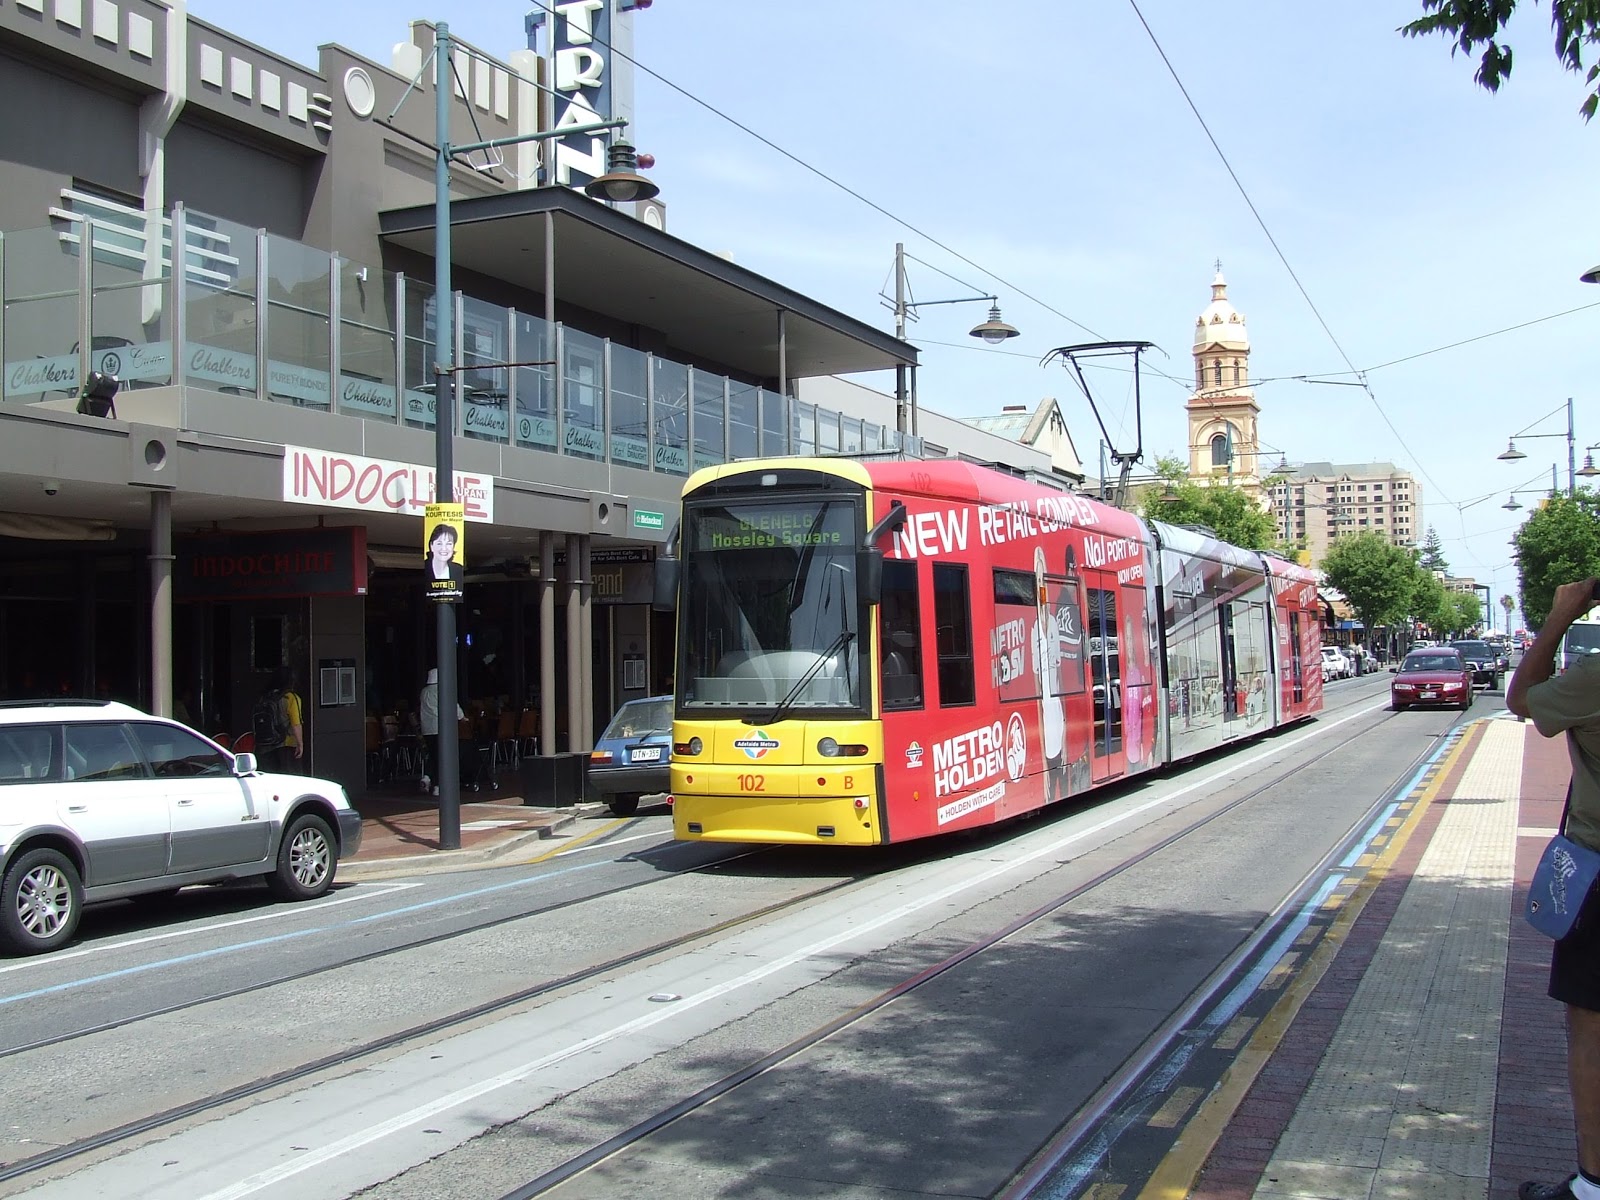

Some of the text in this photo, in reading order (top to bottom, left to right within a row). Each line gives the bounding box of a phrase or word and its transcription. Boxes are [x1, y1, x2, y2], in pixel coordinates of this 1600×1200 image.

[554, 0, 611, 204] TRAN
[11, 362, 75, 390] Chalkers
[191, 349, 252, 380] Chalkers
[343, 381, 393, 408] Chalkers
[466, 407, 506, 431] Chalkers
[294, 451, 489, 519] INDOCHNE
[429, 480, 489, 500] RAURANT
[910, 471, 932, 492] 102
[712, 530, 840, 548] Moseley Square
[893, 495, 1099, 559] NEW RETAIL COMPLEX
[1107, 538, 1127, 564] PORT
[431, 581, 448, 589] VOTE
[990, 617, 1026, 657] METRO
[932, 721, 1003, 773] METRO
[737, 774, 854, 792] 102 B
[934, 750, 1005, 798] HOLDEN
[945, 800, 972, 819] HOLDEN
[972, 793, 988, 808] WITH
